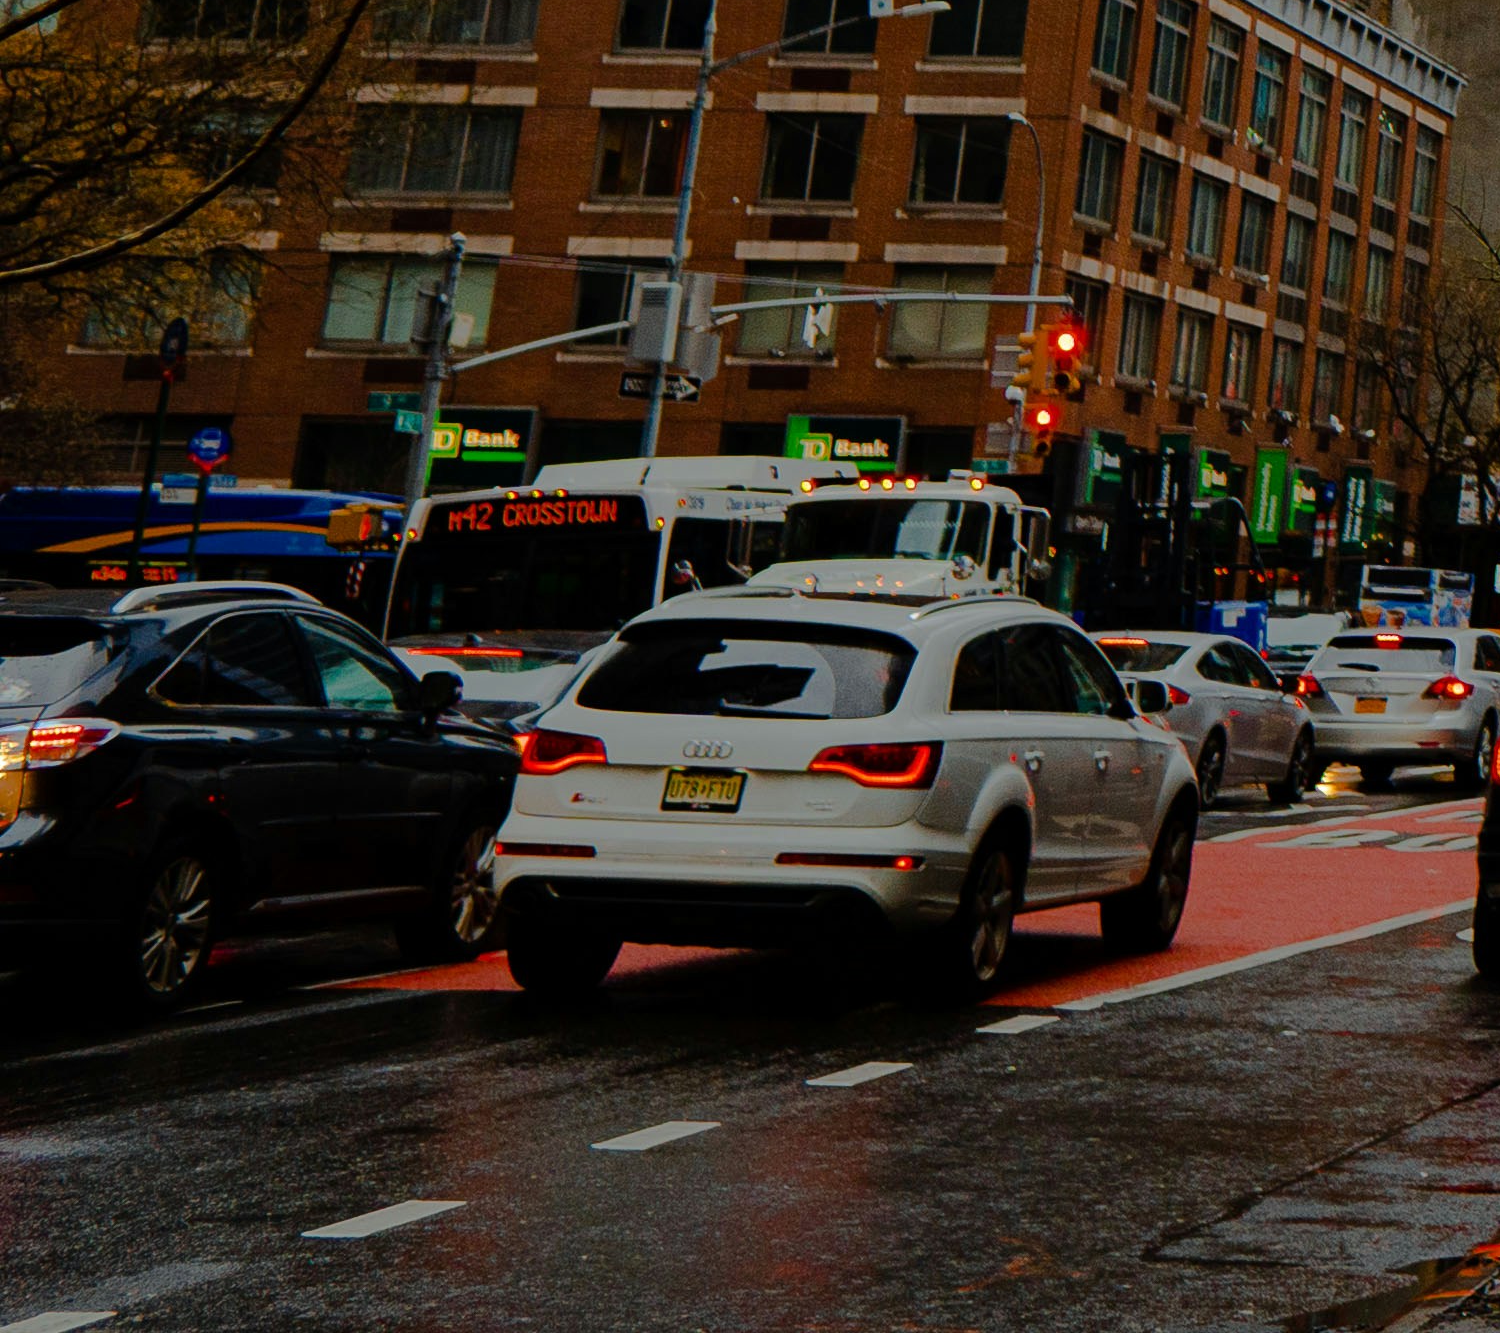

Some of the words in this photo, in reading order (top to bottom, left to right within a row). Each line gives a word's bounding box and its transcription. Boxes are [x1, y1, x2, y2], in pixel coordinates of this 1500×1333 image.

[462, 428, 522, 450] Bank
[834, 438, 891, 458] Bank
[448, 501, 491, 533] M42
[502, 497, 619, 528] CROSSTOWN
